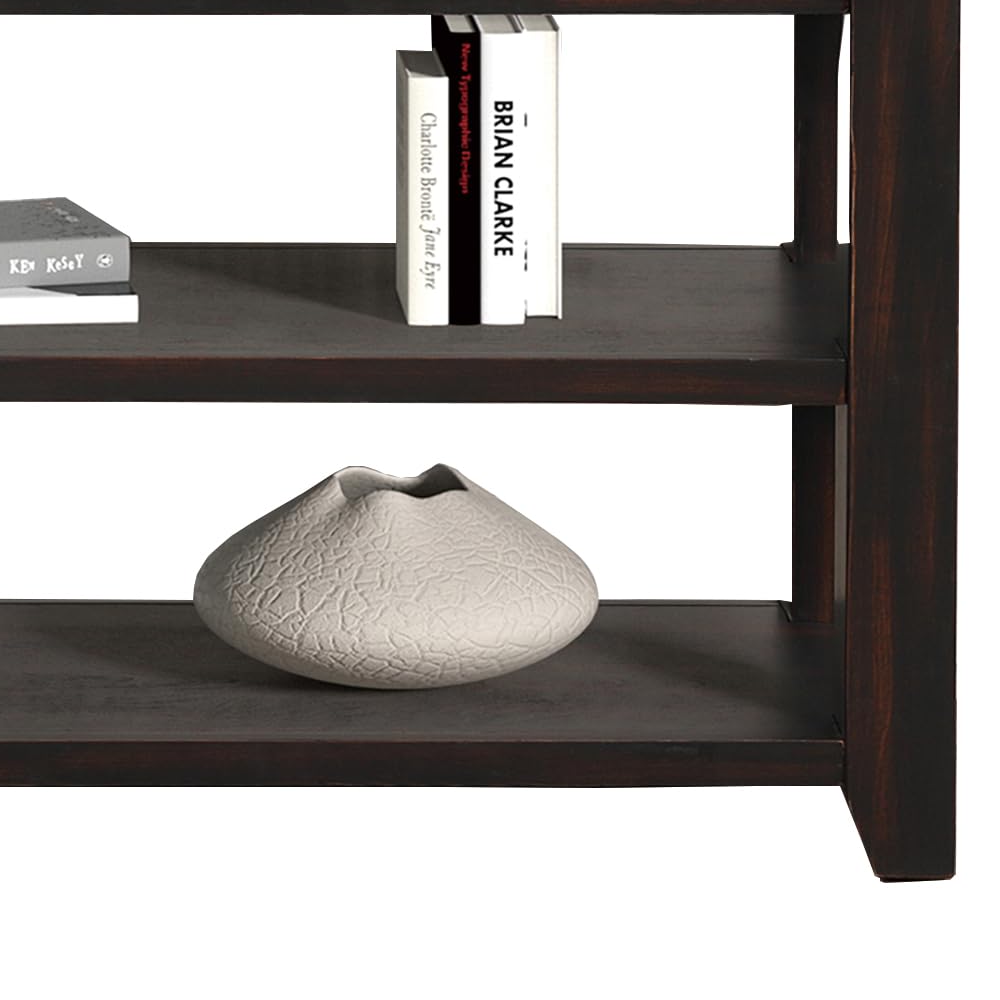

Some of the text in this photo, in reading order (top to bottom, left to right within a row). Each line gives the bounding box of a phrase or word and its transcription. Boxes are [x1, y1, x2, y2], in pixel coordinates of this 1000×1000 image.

[458, 74, 471, 149] Typographic
[461, 43, 471, 72] New
[419, 112, 441, 290] Charlotte Brontë Jane Eyre
[494, 101, 514, 257] BRIAN CLARKE
